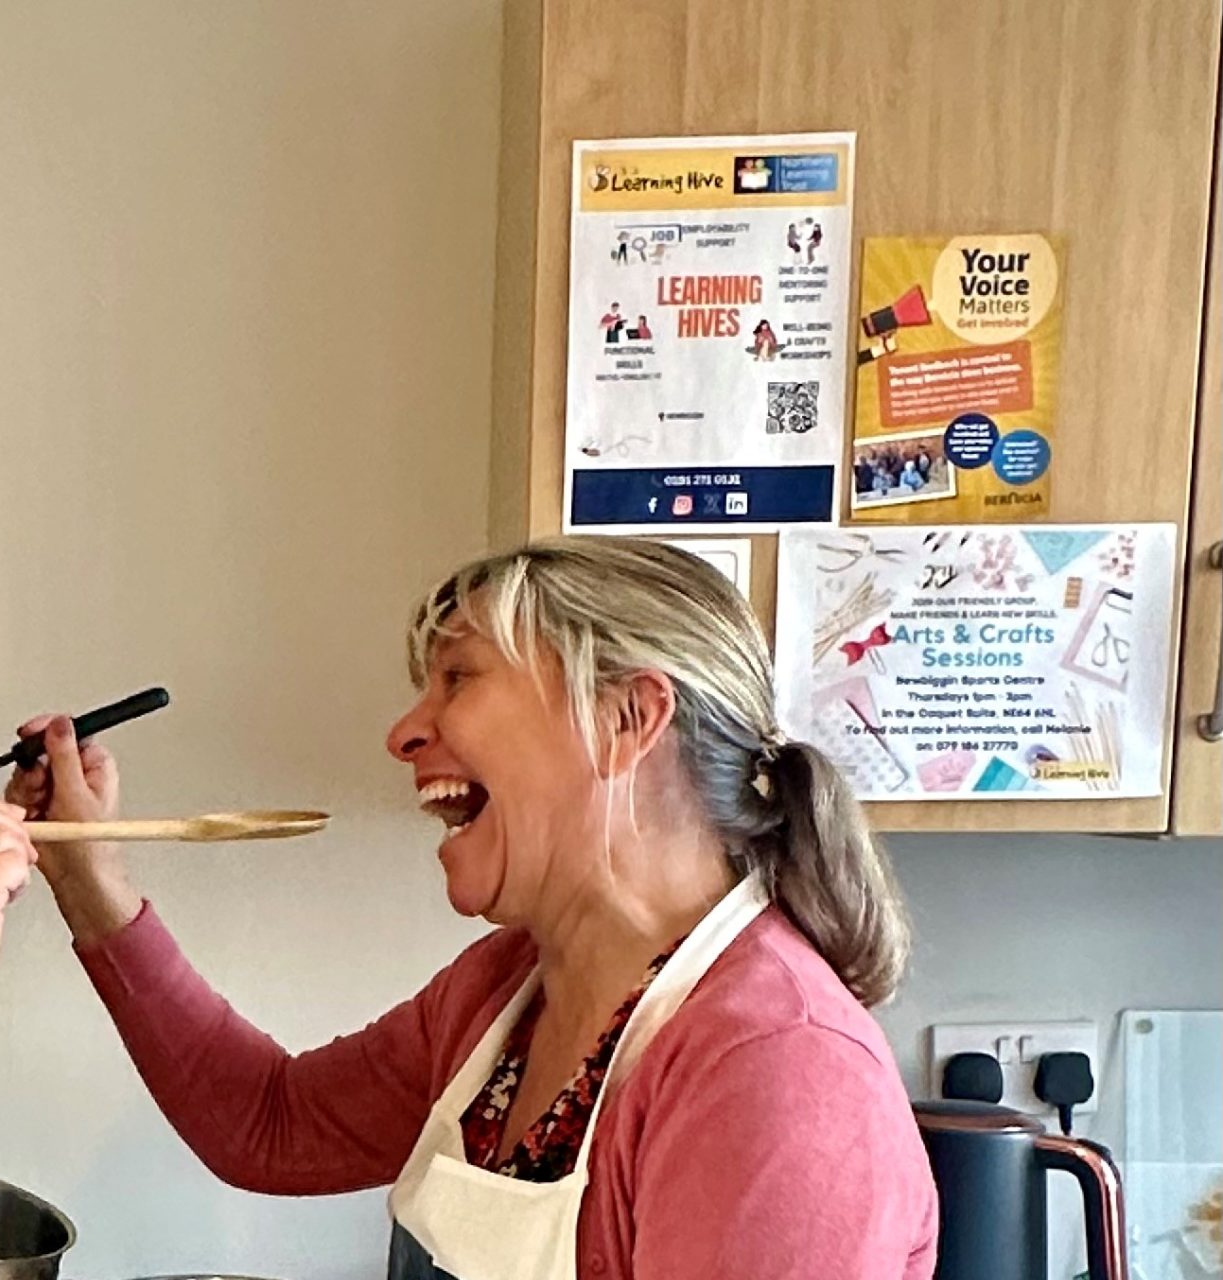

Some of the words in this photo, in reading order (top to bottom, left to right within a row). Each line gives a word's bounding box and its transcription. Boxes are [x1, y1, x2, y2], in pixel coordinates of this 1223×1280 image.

[611, 172, 683, 193] Learning
[687, 172, 724, 189] Hive
[650, 230, 675, 242] JOB
[961, 248, 1030, 274] Your
[657, 275, 763, 305] LEARNING
[959, 274, 1030, 296] Voice
[959, 298, 1030, 315] Matters
[677, 308, 740, 338] HIVES
[892, 624, 945, 644] Arts
[953, 623, 971, 644] &
[979, 622, 1055, 644] Crafts
[922, 646, 1024, 667] Sessions
[1002, 675, 1045, 685] Centre
[908, 691, 969, 703] Thursdays
[845, 724, 861, 735] To
[911, 725, 943, 735] more
